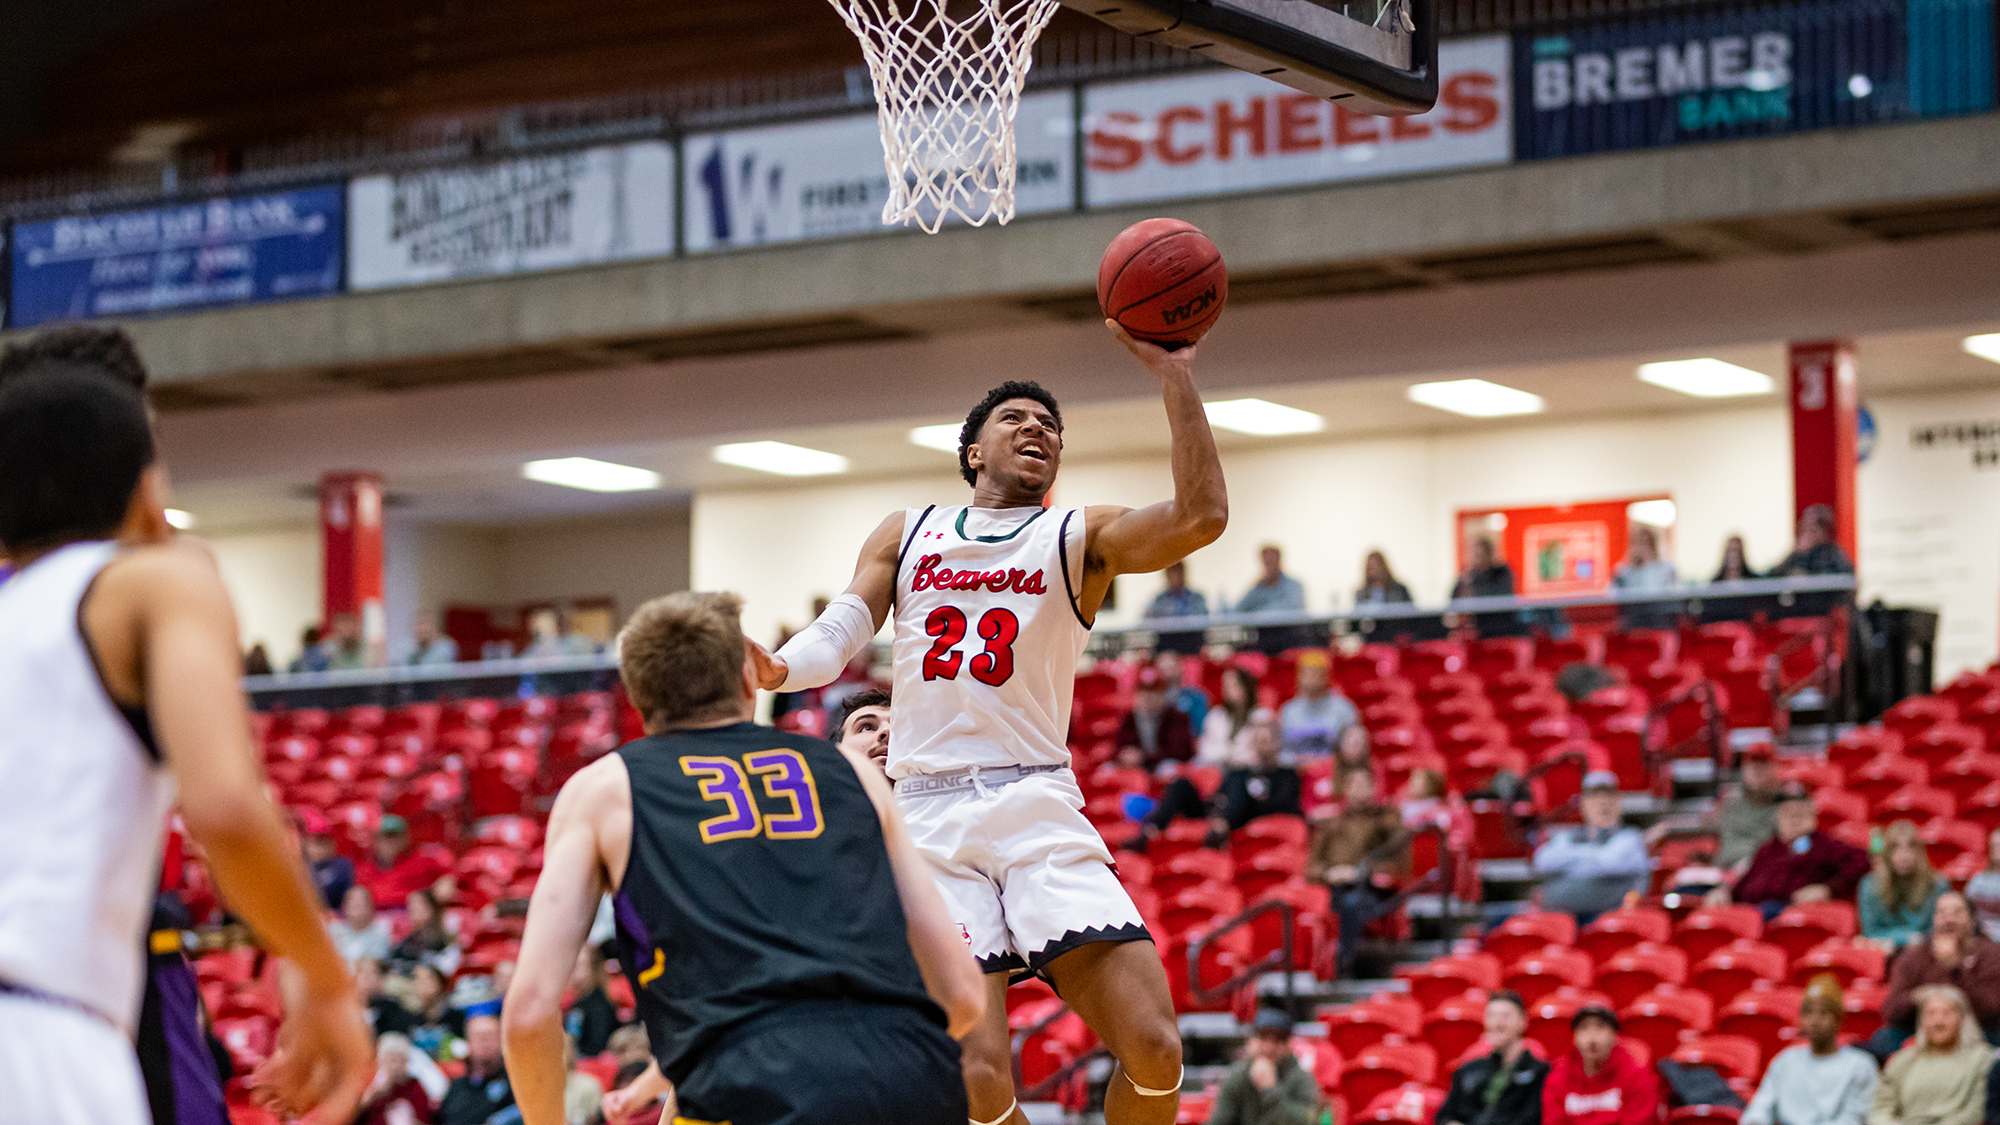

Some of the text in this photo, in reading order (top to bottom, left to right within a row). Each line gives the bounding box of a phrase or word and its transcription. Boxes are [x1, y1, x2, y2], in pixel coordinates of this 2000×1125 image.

[1533, 32, 1791, 111] BREMER
[1678, 86, 1790, 129] BANK
[1161, 284, 1218, 326] NCAA
[911, 553, 1047, 595] Beavers
[922, 605, 1019, 687] 23
[679, 748, 824, 844] 33
